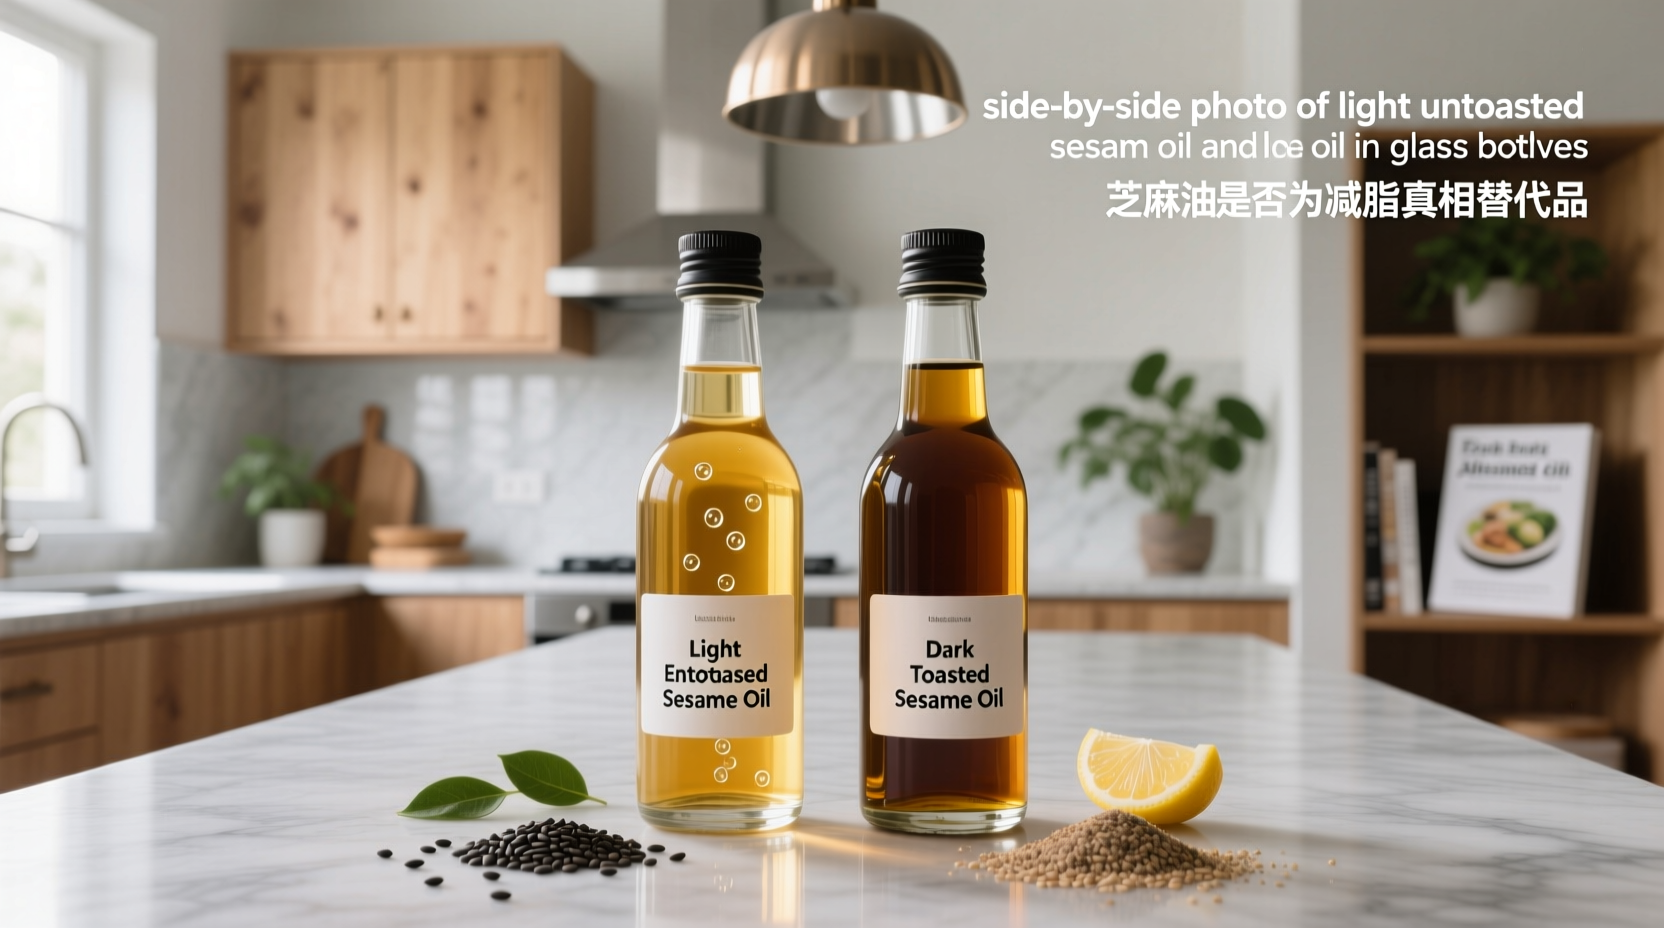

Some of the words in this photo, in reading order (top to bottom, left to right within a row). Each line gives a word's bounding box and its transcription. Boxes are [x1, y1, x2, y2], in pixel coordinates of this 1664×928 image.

[689, 638, 742, 664] Light
[926, 638, 975, 659] Dark
[909, 663, 990, 684] Toasted
[663, 688, 738, 709] Sesame
[743, 687, 771, 709] Oil
[895, 688, 973, 710] Sesame
[977, 686, 1004, 709] Oil
